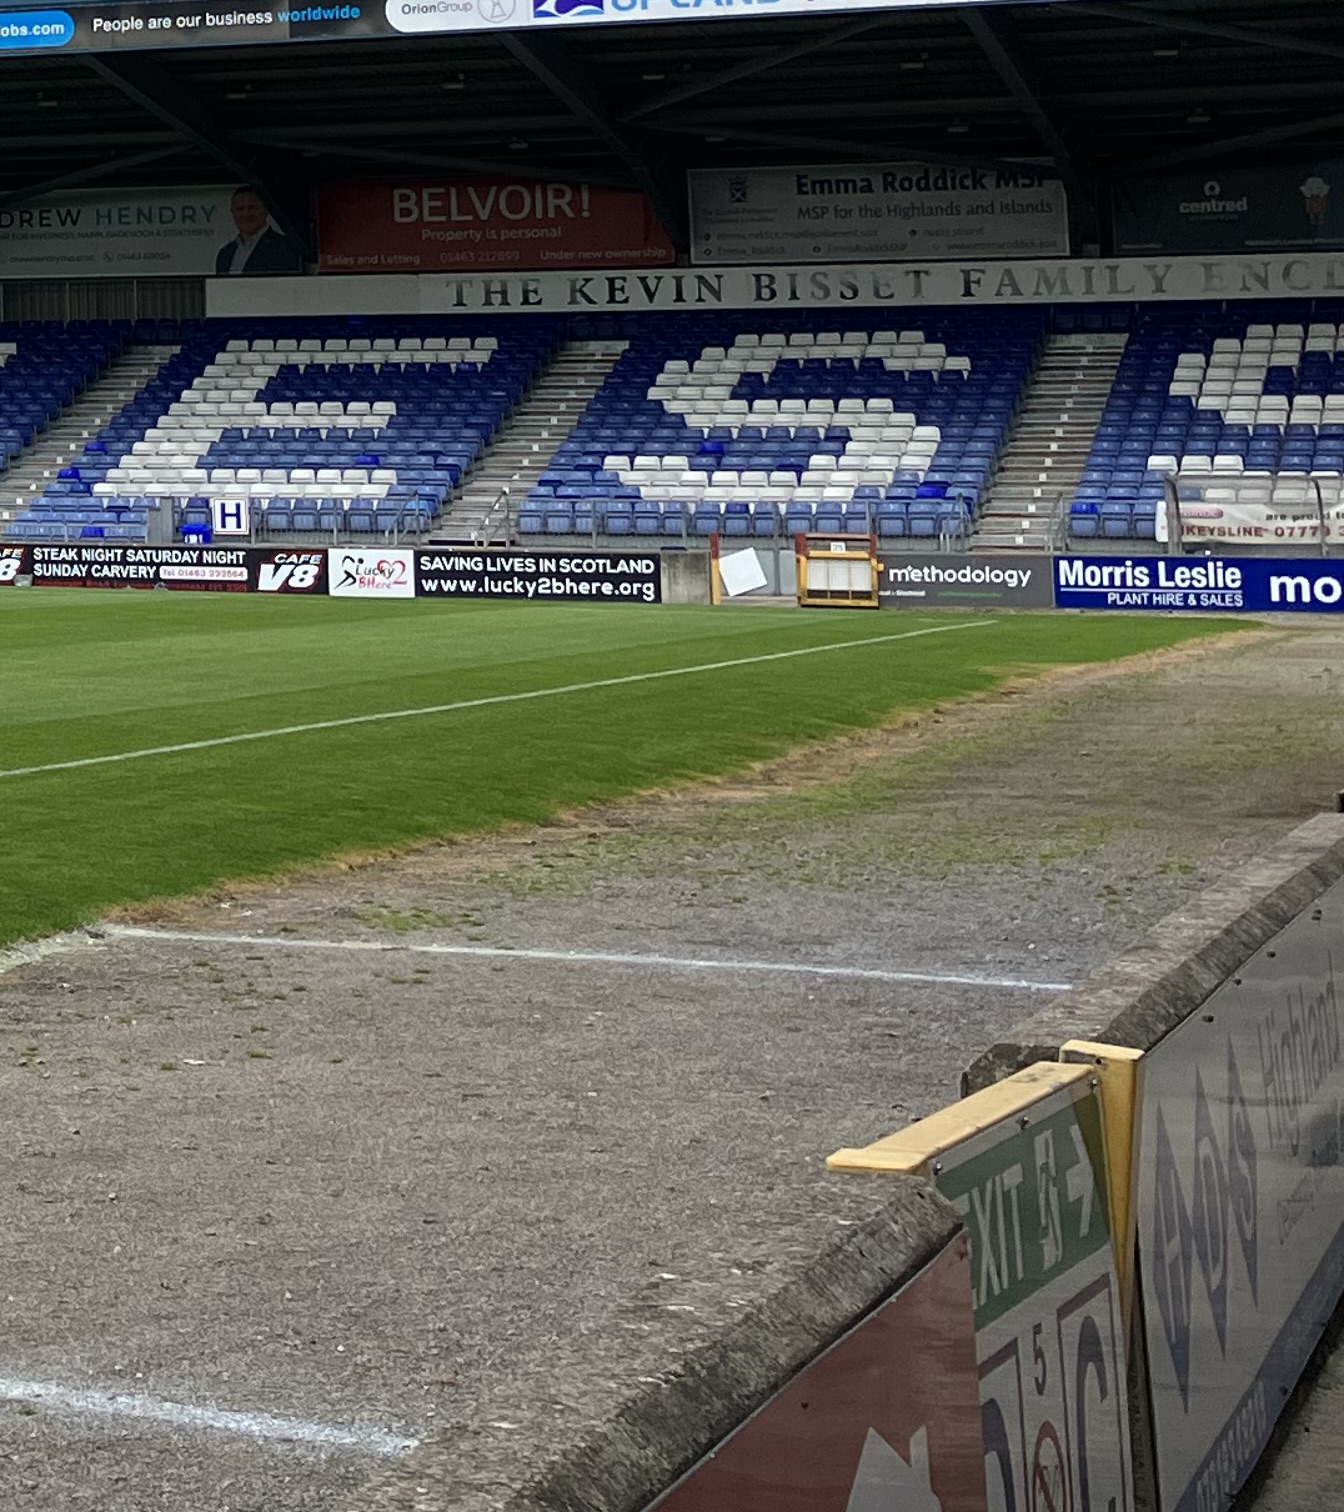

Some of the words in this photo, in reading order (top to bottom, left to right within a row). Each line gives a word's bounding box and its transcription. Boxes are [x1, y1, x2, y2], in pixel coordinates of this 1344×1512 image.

[93, 15, 143, 33] People
[148, 16, 172, 29] are
[175, 15, 202, 28] our
[205, 9, 273, 26] business
[277, 5, 361, 22] worldwide
[401, 0, 473, 16] OrionGroup
[796, 174, 873, 195] Emma
[883, 171, 986, 194] Roddick
[96, 204, 217, 226] HENDRY
[393, 184, 591, 224] BELVOIR!
[797, 206, 829, 220] MSP
[834, 204, 854, 219] for
[859, 203, 882, 218] the
[887, 201, 962, 220] Highlands
[966, 201, 994, 216] and
[1000, 199, 1053, 215] Islands
[421, 227, 482, 243] Property
[500, 225, 561, 241] personal
[327, 254, 356, 266] Sales
[446, 279, 543, 307] THE
[567, 272, 725, 306] KEVIN
[751, 268, 933, 302] BISSET
[959, 263, 1173, 299] FAMILY
[220, 502, 242, 529] H
[1180, 525, 1264, 537] KEYSLINE
[33, 547, 79, 563] STEAK
[81, 548, 123, 564] NIGHT
[126, 548, 199, 565] SATURDAY
[201, 550, 247, 565] NIGHT
[274, 553, 323, 565] CAFE
[420, 556, 484, 572] SAVING
[486, 557, 536, 572] LIVES
[540, 557, 558, 572] IN
[559, 558, 655, 574] SCOTLAND
[33, 563, 88, 577] SUNDAY
[90, 563, 158, 578] CARVERY
[257, 565, 320, 592] V8
[889, 564, 1031, 588] methodology
[1059, 559, 1149, 587] Morris
[1158, 560, 1243, 588] Leslie
[421, 575, 656, 601] www.lucky2bhere.org
[1108, 592, 1150, 606] PLANT
[1153, 592, 1184, 606] HIRE
[1187, 593, 1197, 606] &
[1198, 593, 1244, 607] SALES
[1257, 948, 1340, 1157] Highland
